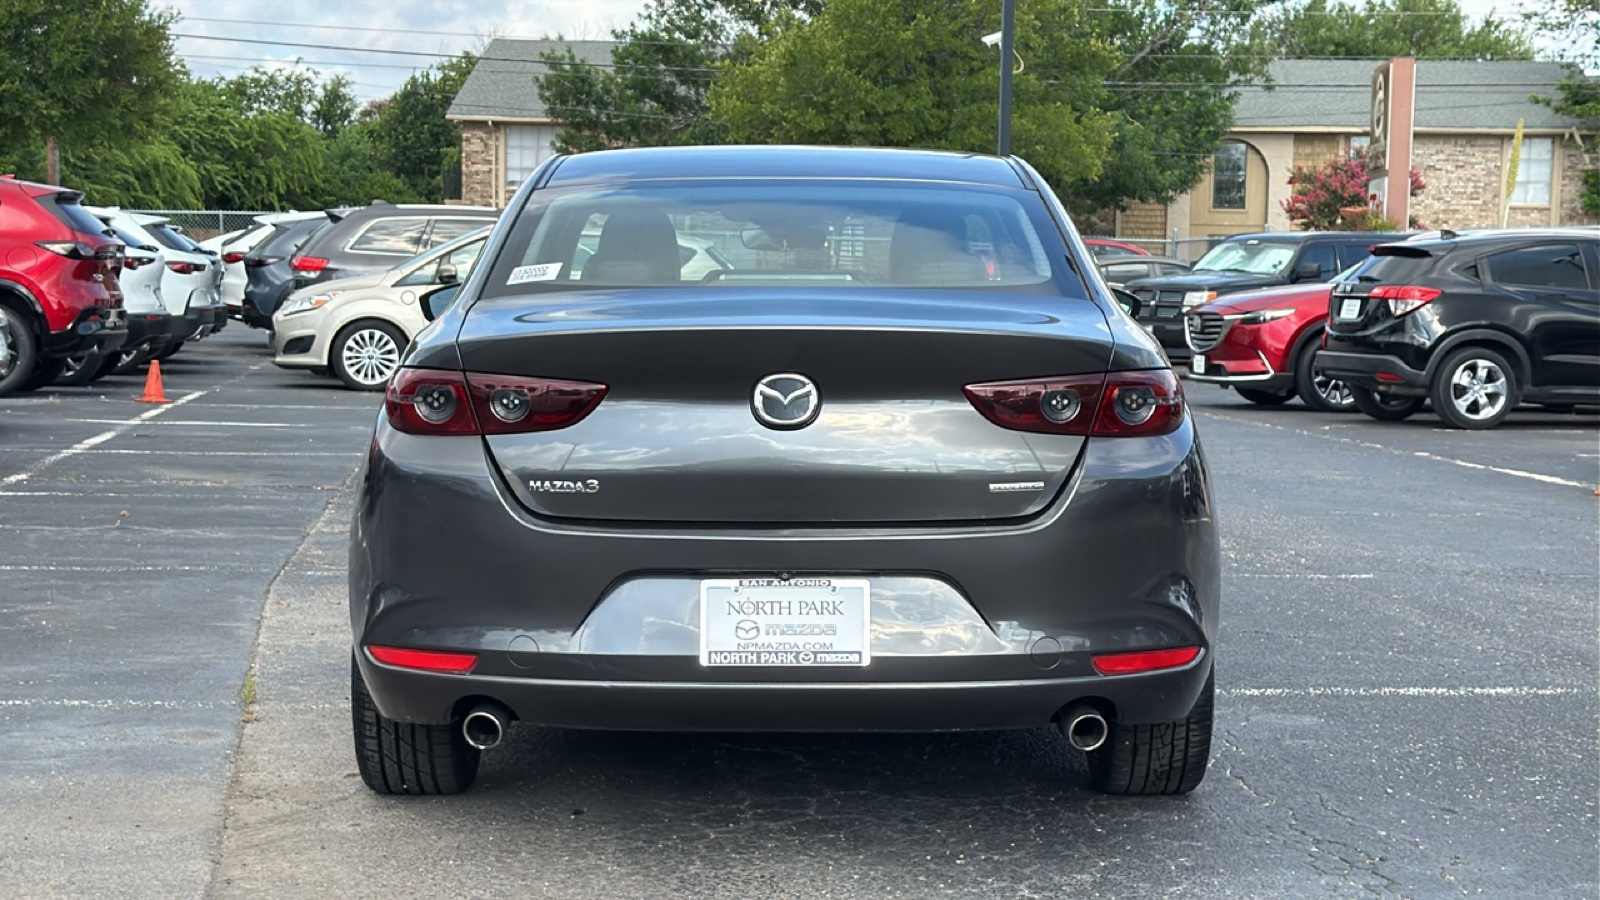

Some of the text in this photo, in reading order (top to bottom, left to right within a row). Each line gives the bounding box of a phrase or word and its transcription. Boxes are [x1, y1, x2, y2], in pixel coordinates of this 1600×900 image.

[529, 478, 600, 493] MAZDA3
[741, 579, 830, 587] SAN ANTONIO
[726, 600, 845, 616] NORTH PARK
[765, 624, 837, 636] mazda
[737, 642, 834, 651] NPMAZDA.COM
[710, 652, 860, 664] NORTH PARK mazda
